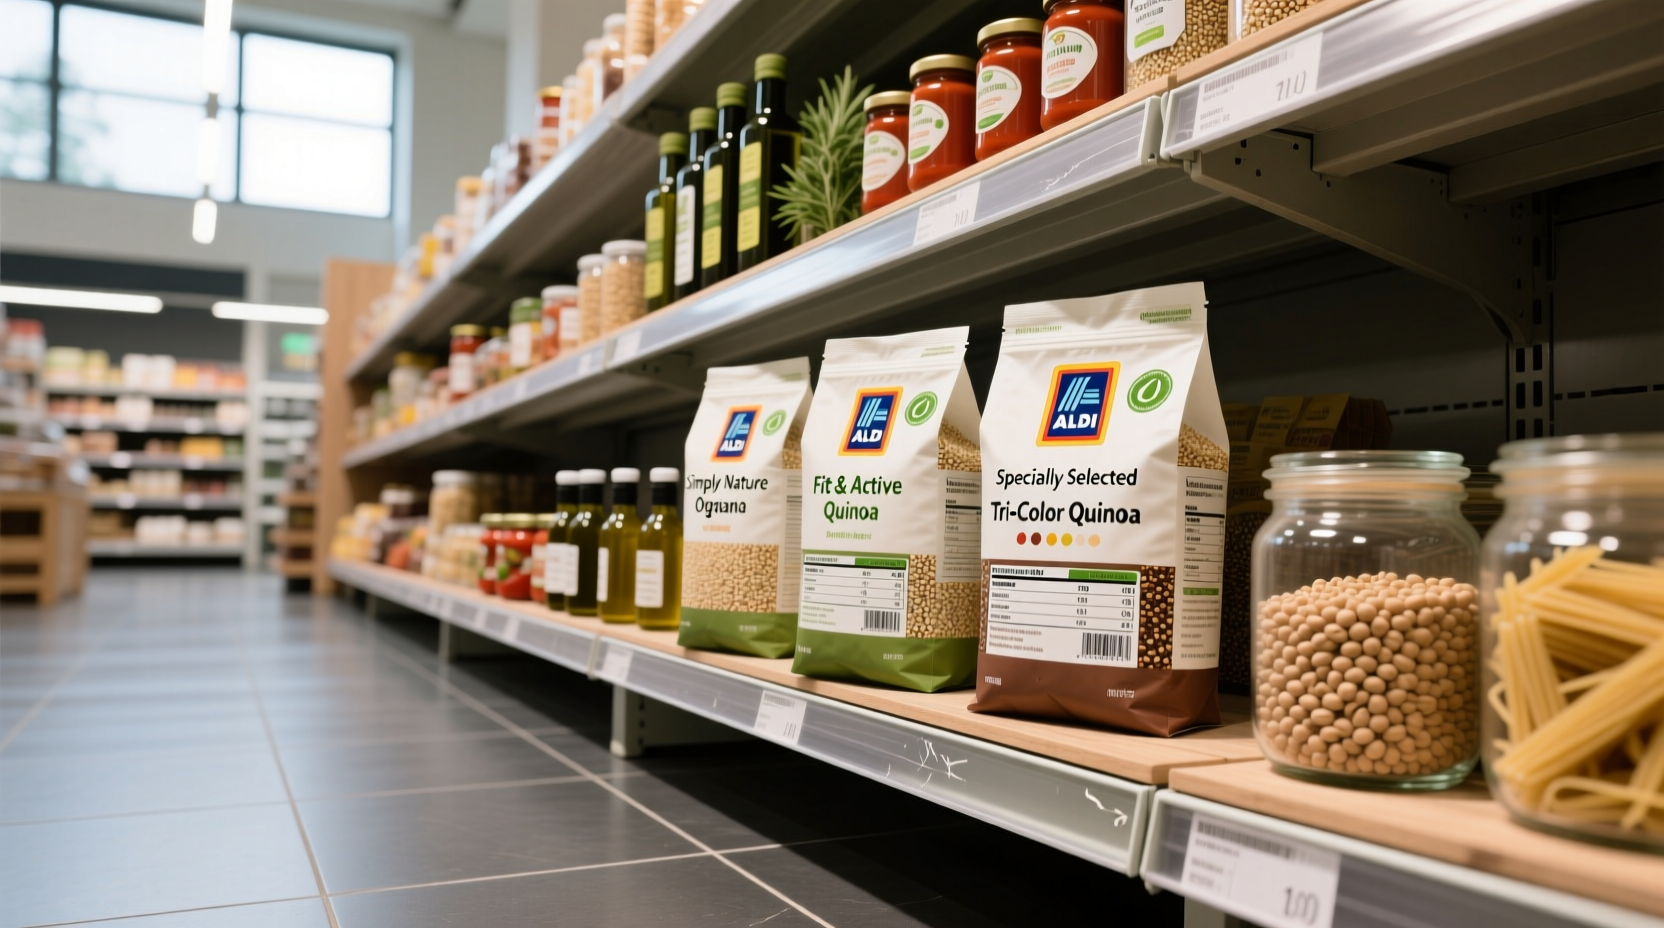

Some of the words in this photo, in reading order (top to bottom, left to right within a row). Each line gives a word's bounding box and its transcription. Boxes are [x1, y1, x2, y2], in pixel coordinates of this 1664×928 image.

[1052, 413, 1098, 430] ALDI
[686, 473, 722, 494] Simply
[724, 474, 768, 490] Nature
[813, 475, 832, 494] Fit
[834, 475, 847, 494] &
[850, 475, 903, 495] Active
[995, 468, 1064, 491] Specially
[1067, 467, 1138, 486] Selected
[823, 501, 879, 523] Quinoa
[990, 500, 1065, 523] Tri-Color
[1068, 501, 1141, 526] Quinoa
